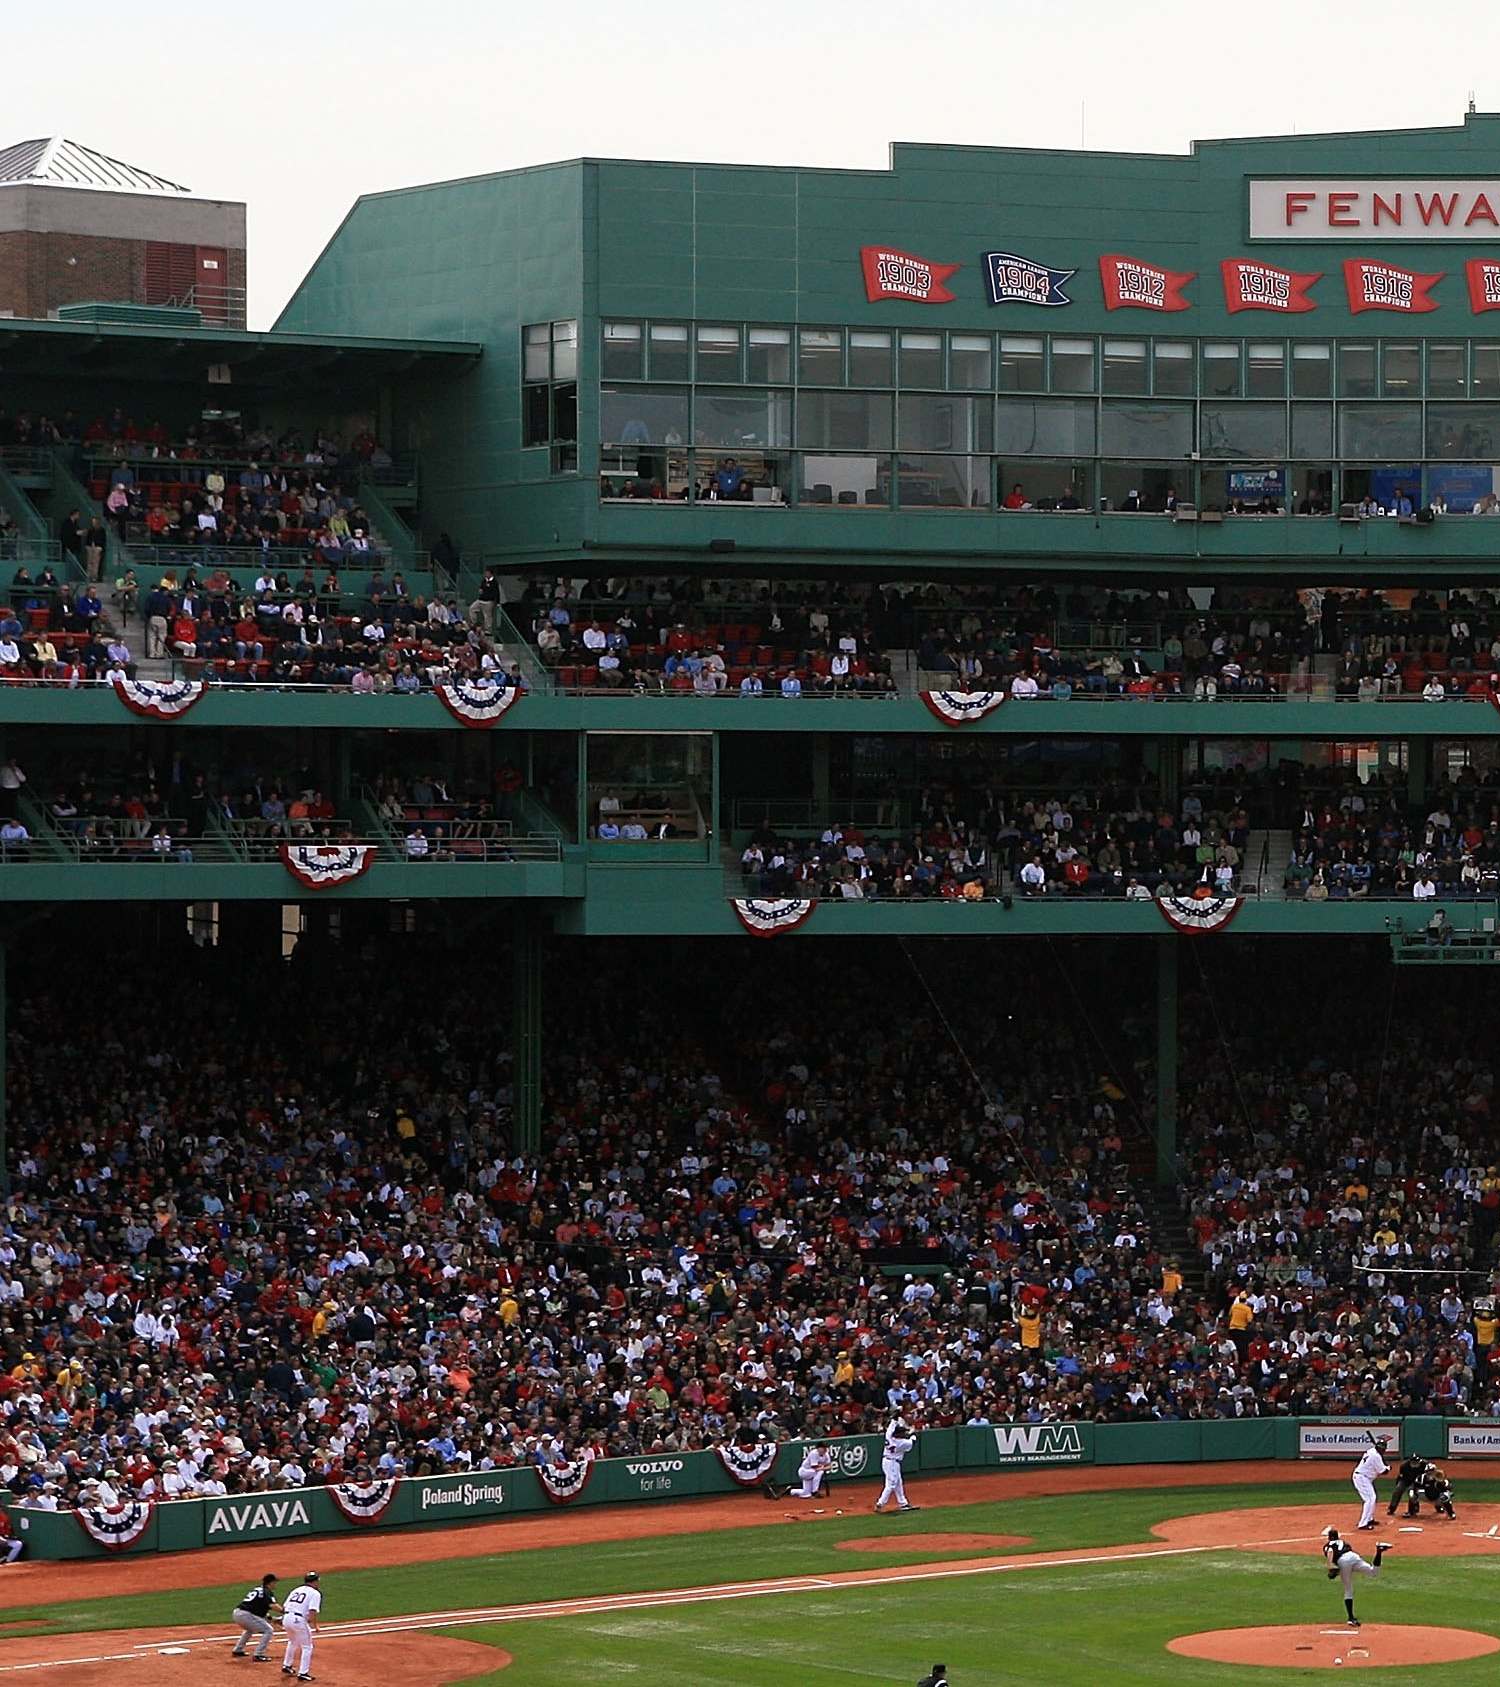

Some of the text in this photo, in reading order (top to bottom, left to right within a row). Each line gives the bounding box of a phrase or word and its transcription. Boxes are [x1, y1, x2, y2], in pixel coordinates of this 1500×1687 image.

[878, 253, 929, 271] WORLD SERIES
[999, 259, 1048, 275] AMERICAN LEAGUE
[878, 261, 931, 290] 1903
[1116, 262, 1165, 280] WORLD SERIES
[1238, 265, 1290, 281] WORLD SERIES
[1361, 266, 1413, 281] WORLD SERIES
[998, 266, 1049, 295] 1904
[1118, 270, 1165, 298] 1912
[1240, 272, 1289, 299] 1915
[1363, 273, 1412, 300] 1916
[882, 283, 927, 298] CHAMPIONS
[1002, 288, 1047, 302] CHAMPIONS
[1120, 291, 1163, 306] CHAMPIONS
[1241, 294, 1288, 307] CHAMPIONS
[1364, 294, 1411, 308] CHAMPIONS
[994, 1426, 1082, 1454] WM
[1304, 1434, 1372, 1443] Bank of Americ
[1453, 1435, 1476, 1444] Bank
[1477, 1435, 1486, 1445] of
[626, 1460, 683, 1475] VOLVO
[640, 1476, 672, 1491] for life
[422, 1483, 503, 1509] Poland Spring
[208, 1500, 310, 1534] AVAYA
[290, 1592, 306, 1604] 20
